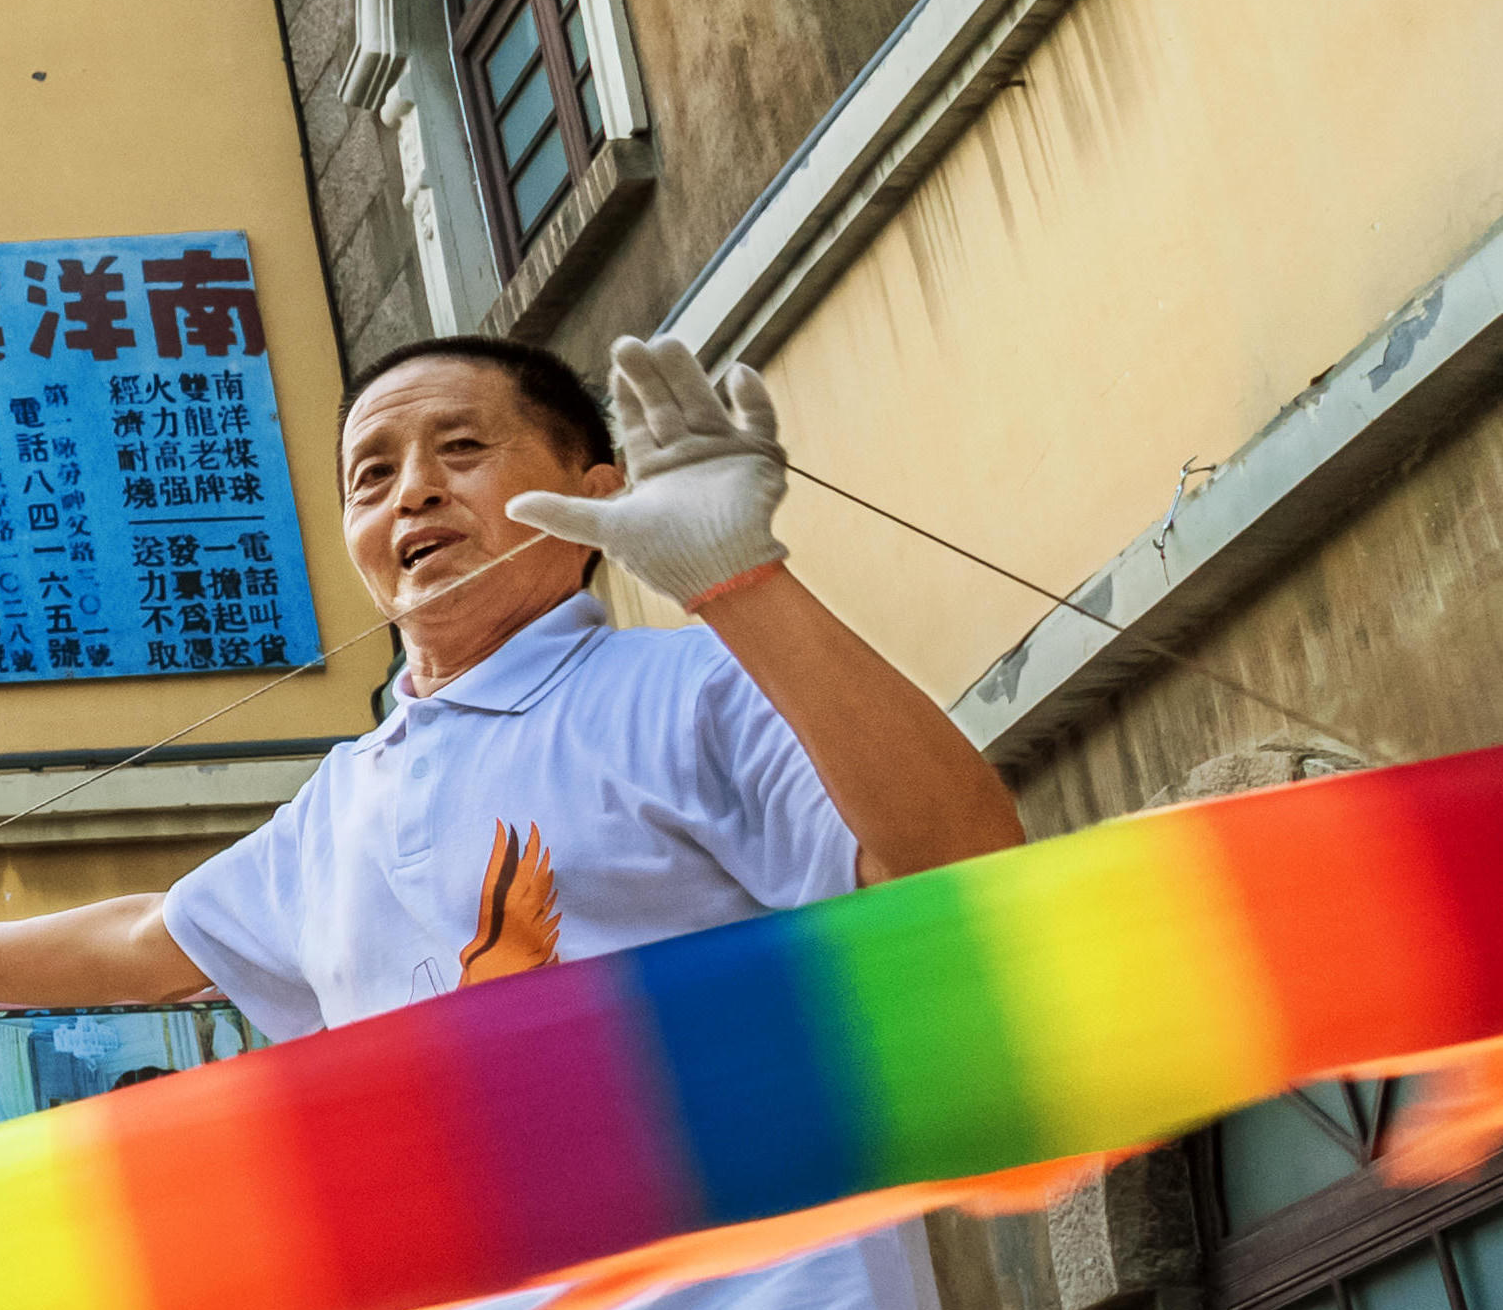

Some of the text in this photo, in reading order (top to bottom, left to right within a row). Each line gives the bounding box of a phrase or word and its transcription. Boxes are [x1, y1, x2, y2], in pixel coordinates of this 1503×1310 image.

[212, 370, 265, 505] 南洋煤球
[132, 535, 181, 670] 送力不取
[238, 531, 290, 667] 電話叫貨
